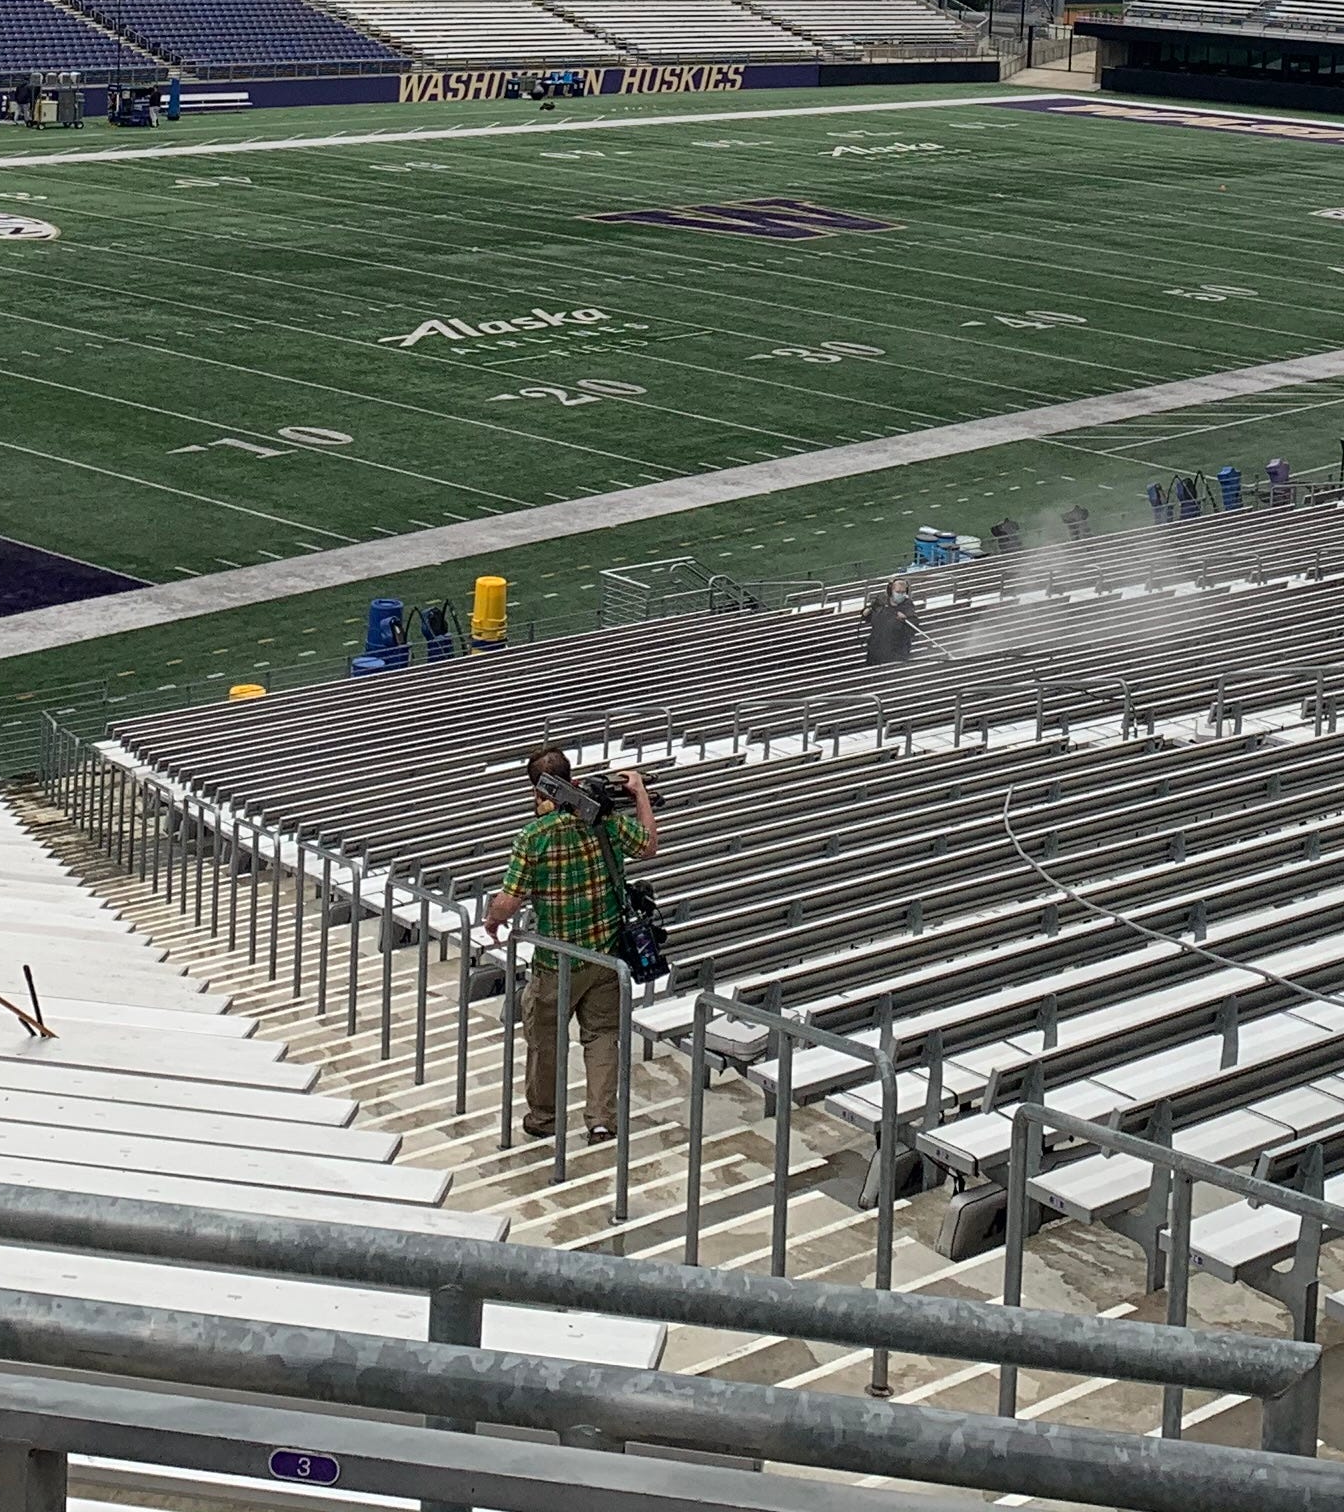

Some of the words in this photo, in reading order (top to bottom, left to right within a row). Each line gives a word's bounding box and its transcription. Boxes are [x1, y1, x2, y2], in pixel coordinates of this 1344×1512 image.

[619, 65, 746, 95] HUSKIES
[818, 142, 944, 157] Alaska
[572, 196, 908, 242] W
[1163, 285, 1258, 302] 50
[378, 308, 611, 347] Alaska
[993, 310, 1087, 329] 40
[450, 322, 649, 355] AIRLINES
[549, 339, 649, 358] FIELD
[780, 340, 886, 365] 30
[519, 379, 647, 407] 20
[206, 425, 354, 459] 10
[297, 1457, 311, 1477] 3
